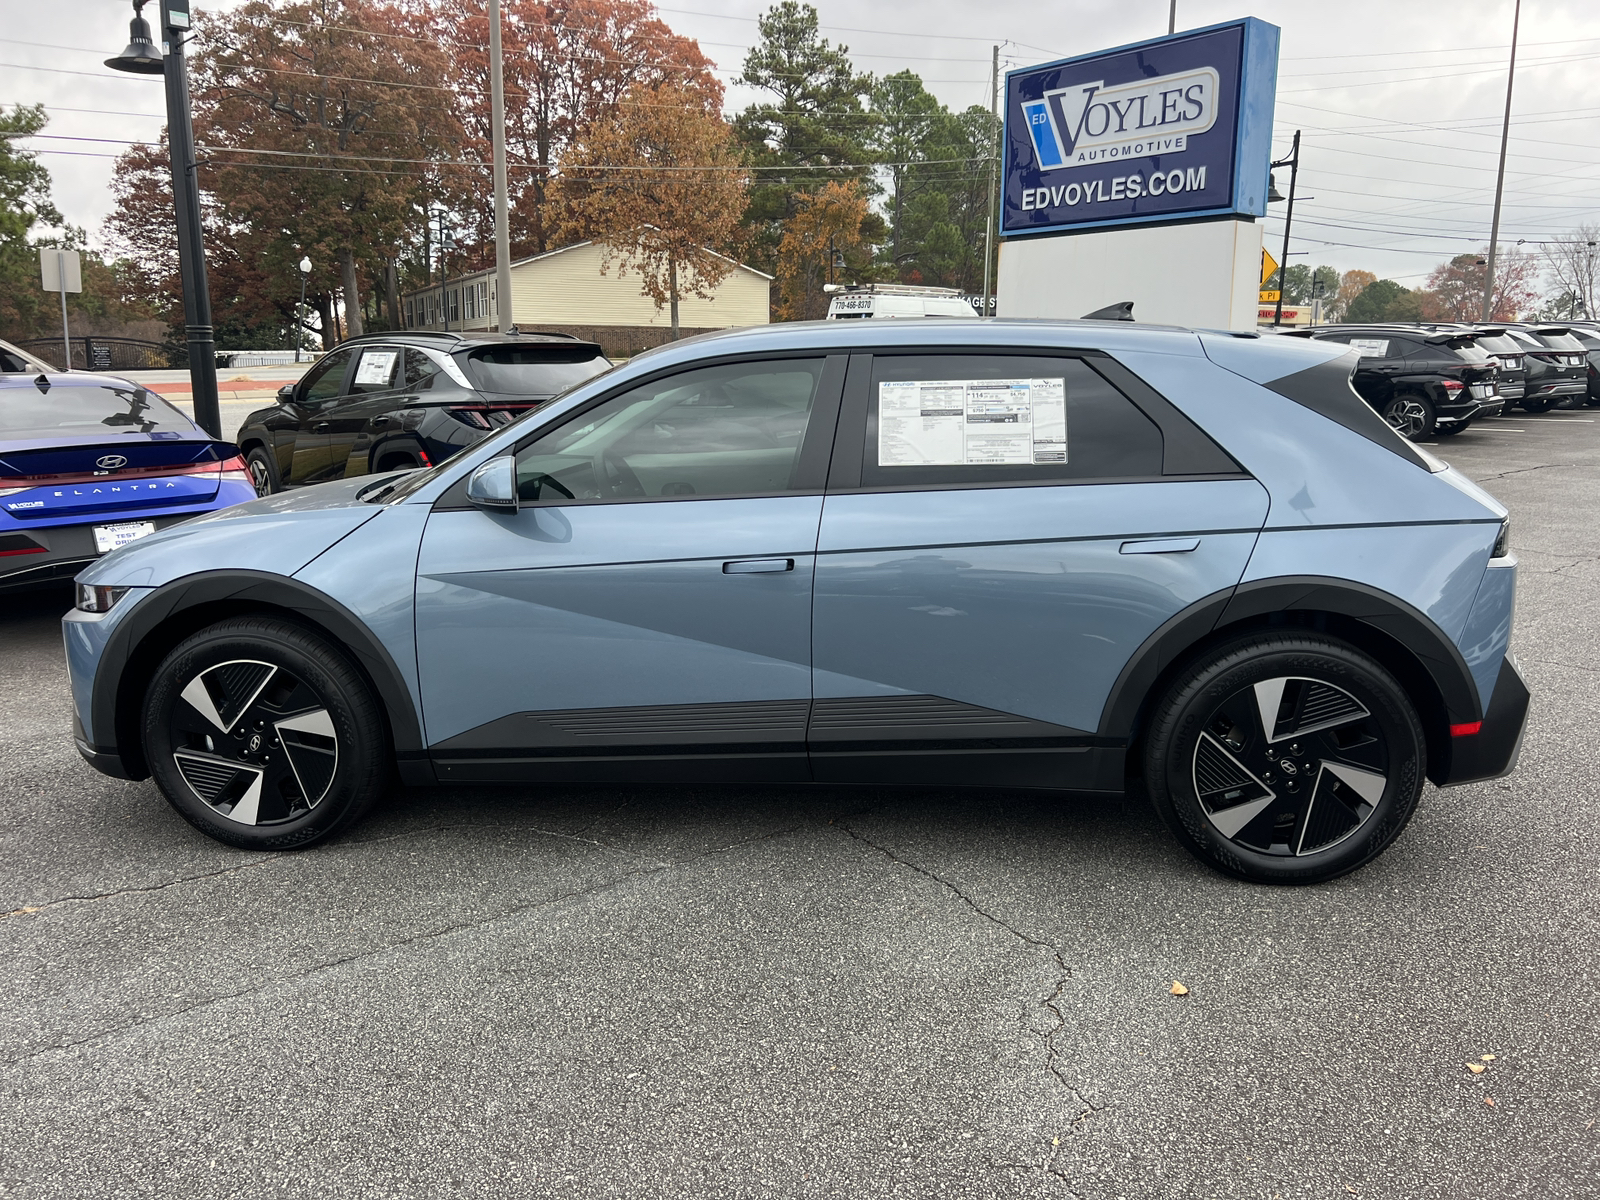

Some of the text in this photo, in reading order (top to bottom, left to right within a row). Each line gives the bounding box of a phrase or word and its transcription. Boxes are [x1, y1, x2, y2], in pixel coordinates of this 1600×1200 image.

[1031, 112, 1048, 126] ED
[1047, 84, 1205, 157] VOYLES
[1077, 137, 1184, 163] AUTOMOTIVE
[1021, 166, 1207, 211] EDVOYLES.COM
[53, 482, 175, 497] ELANTRA
[115, 538, 136, 546] DRIV
